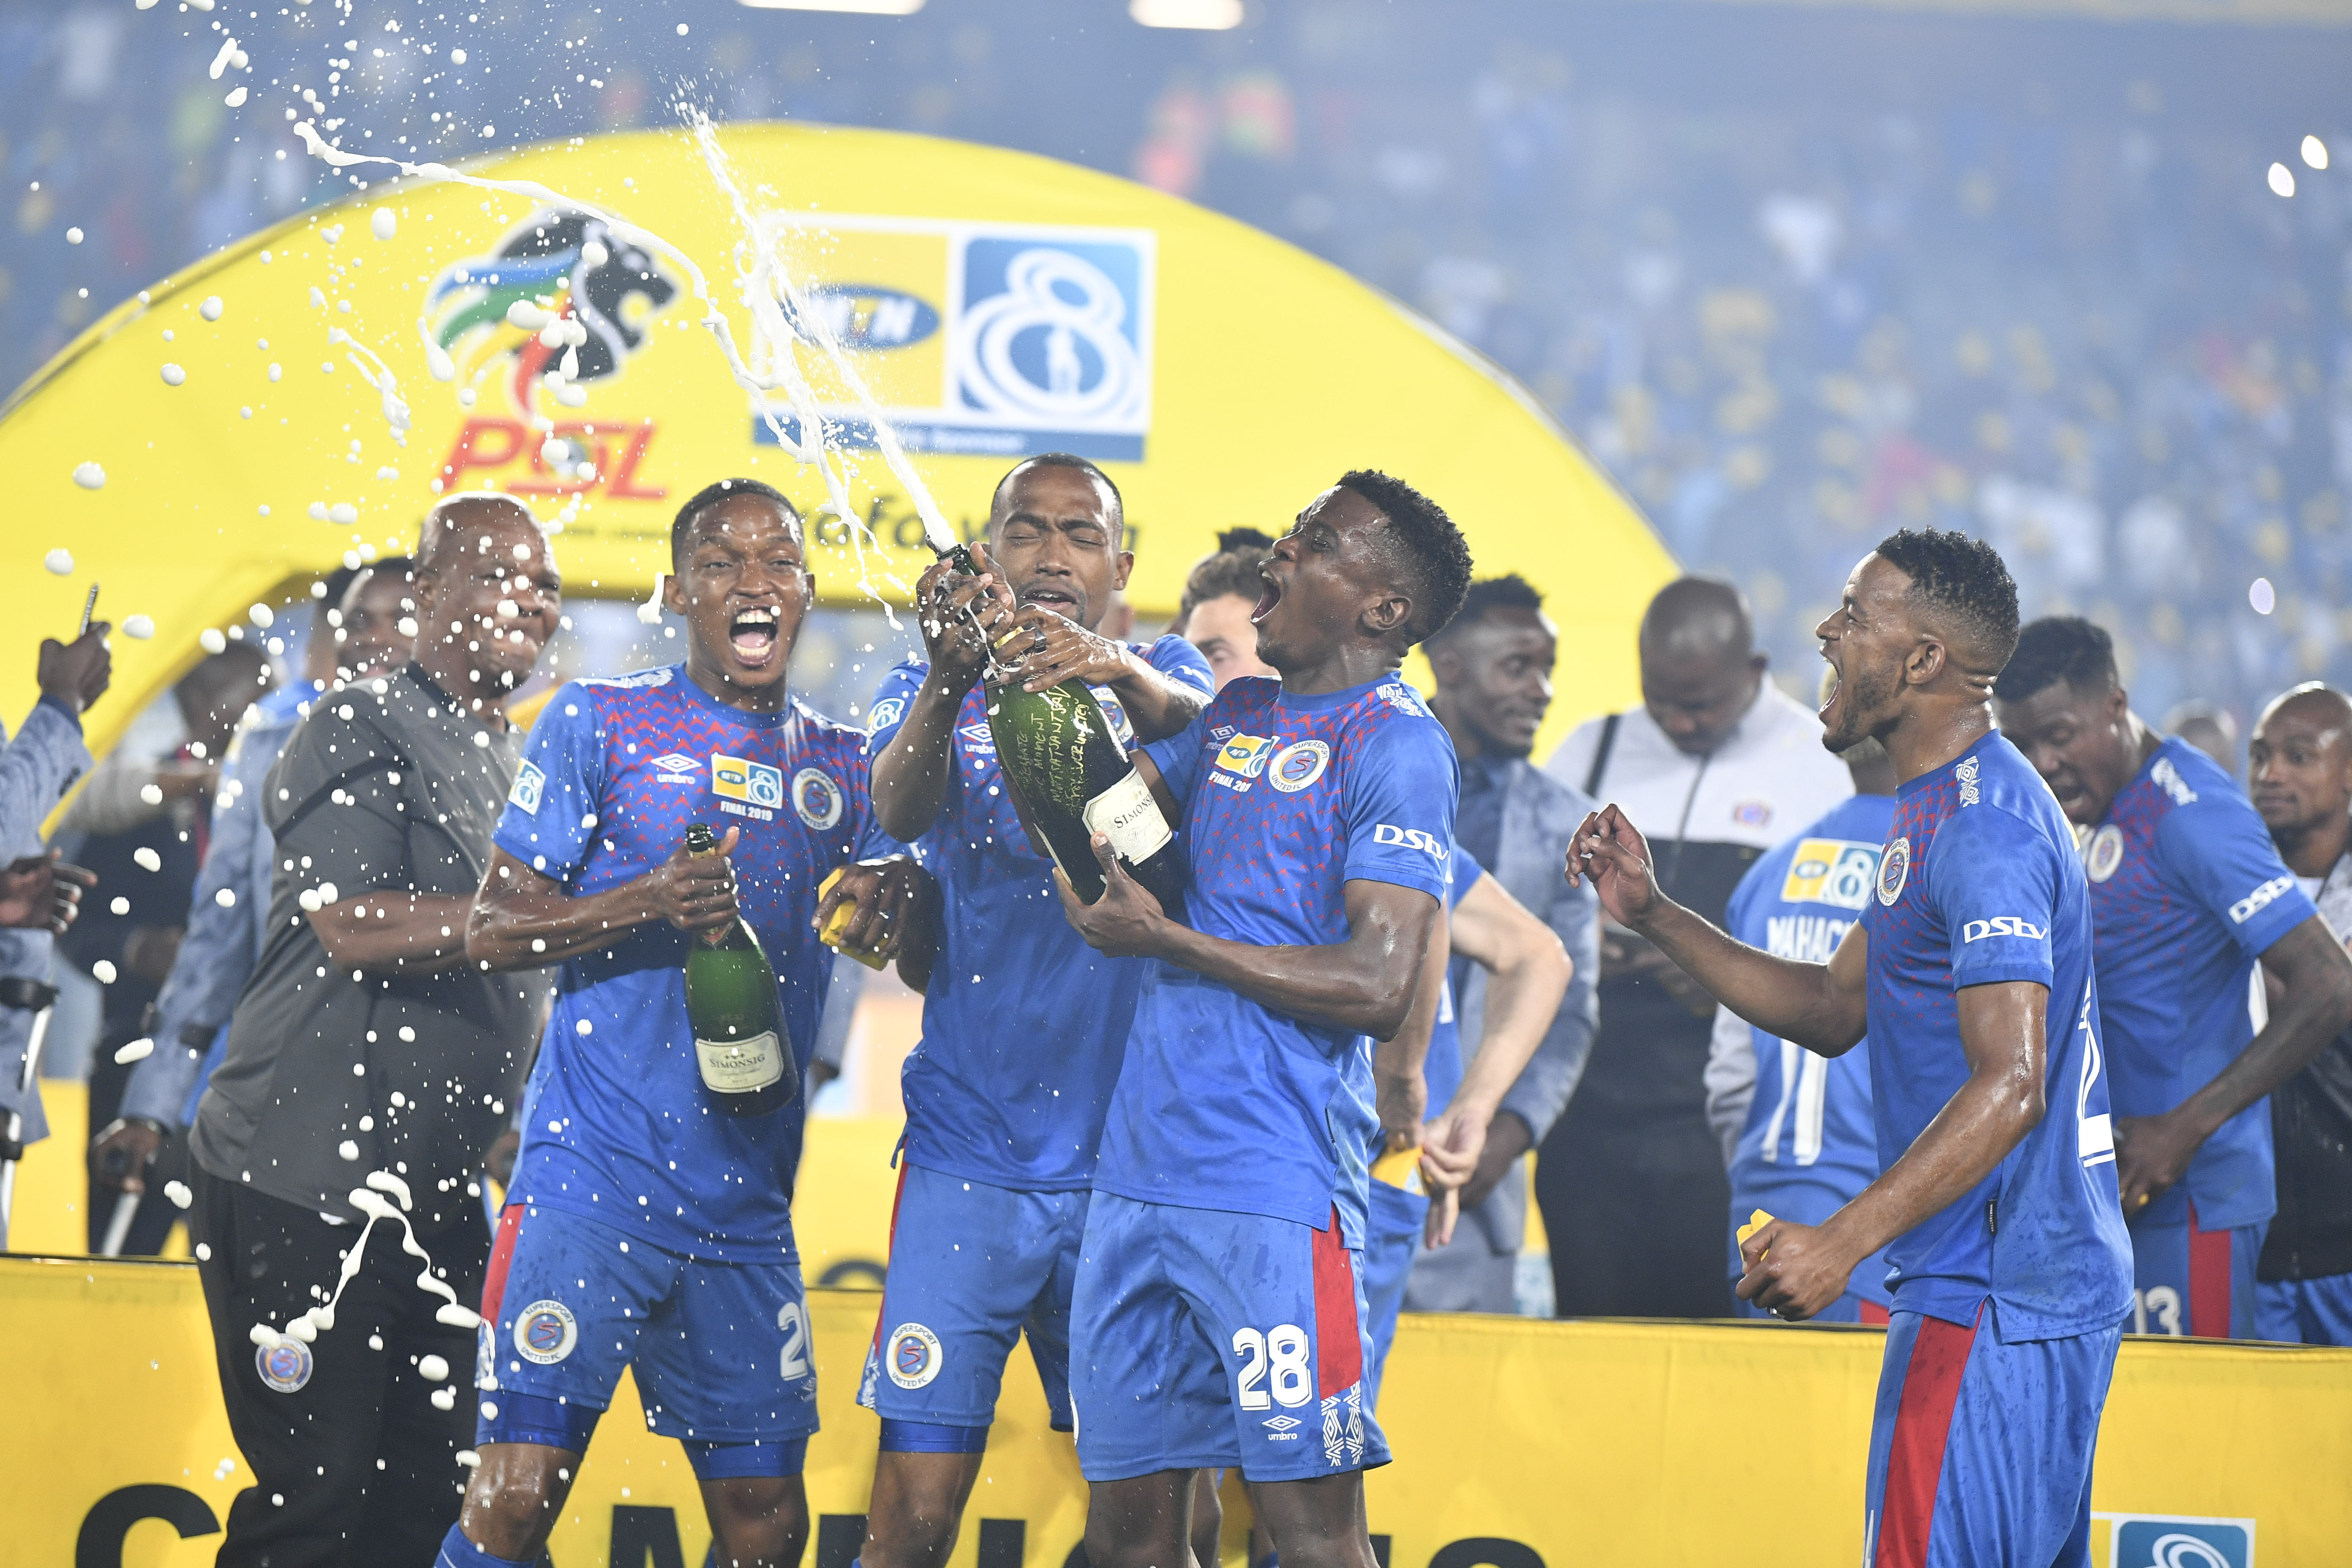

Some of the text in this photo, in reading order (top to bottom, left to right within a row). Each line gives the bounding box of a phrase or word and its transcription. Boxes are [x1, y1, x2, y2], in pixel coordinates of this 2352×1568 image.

[964, 743, 996, 754] umbr
[1293, 741, 1328, 759] SUPERSPORT
[656, 773, 695, 785] umbro
[721, 771, 742, 783] MTN
[1208, 770, 1234, 788] FINAL
[1271, 774, 1292, 791] UNITED
[720, 800, 773, 822] FINAL 2019
[1373, 823, 1450, 861] DStv
[1963, 916, 2048, 944] DStv
[709, 1054, 765, 1069] SIMONSIG
[525, 1302, 573, 1323] SUPERSPORT
[894, 1325, 937, 1345] SUPERSPORT
[521, 1346, 550, 1362] UNITED
[1232, 1323, 1313, 1411] 28
[892, 1372, 928, 1387] UNITED FC
[1268, 1432, 1298, 1440] umbro
